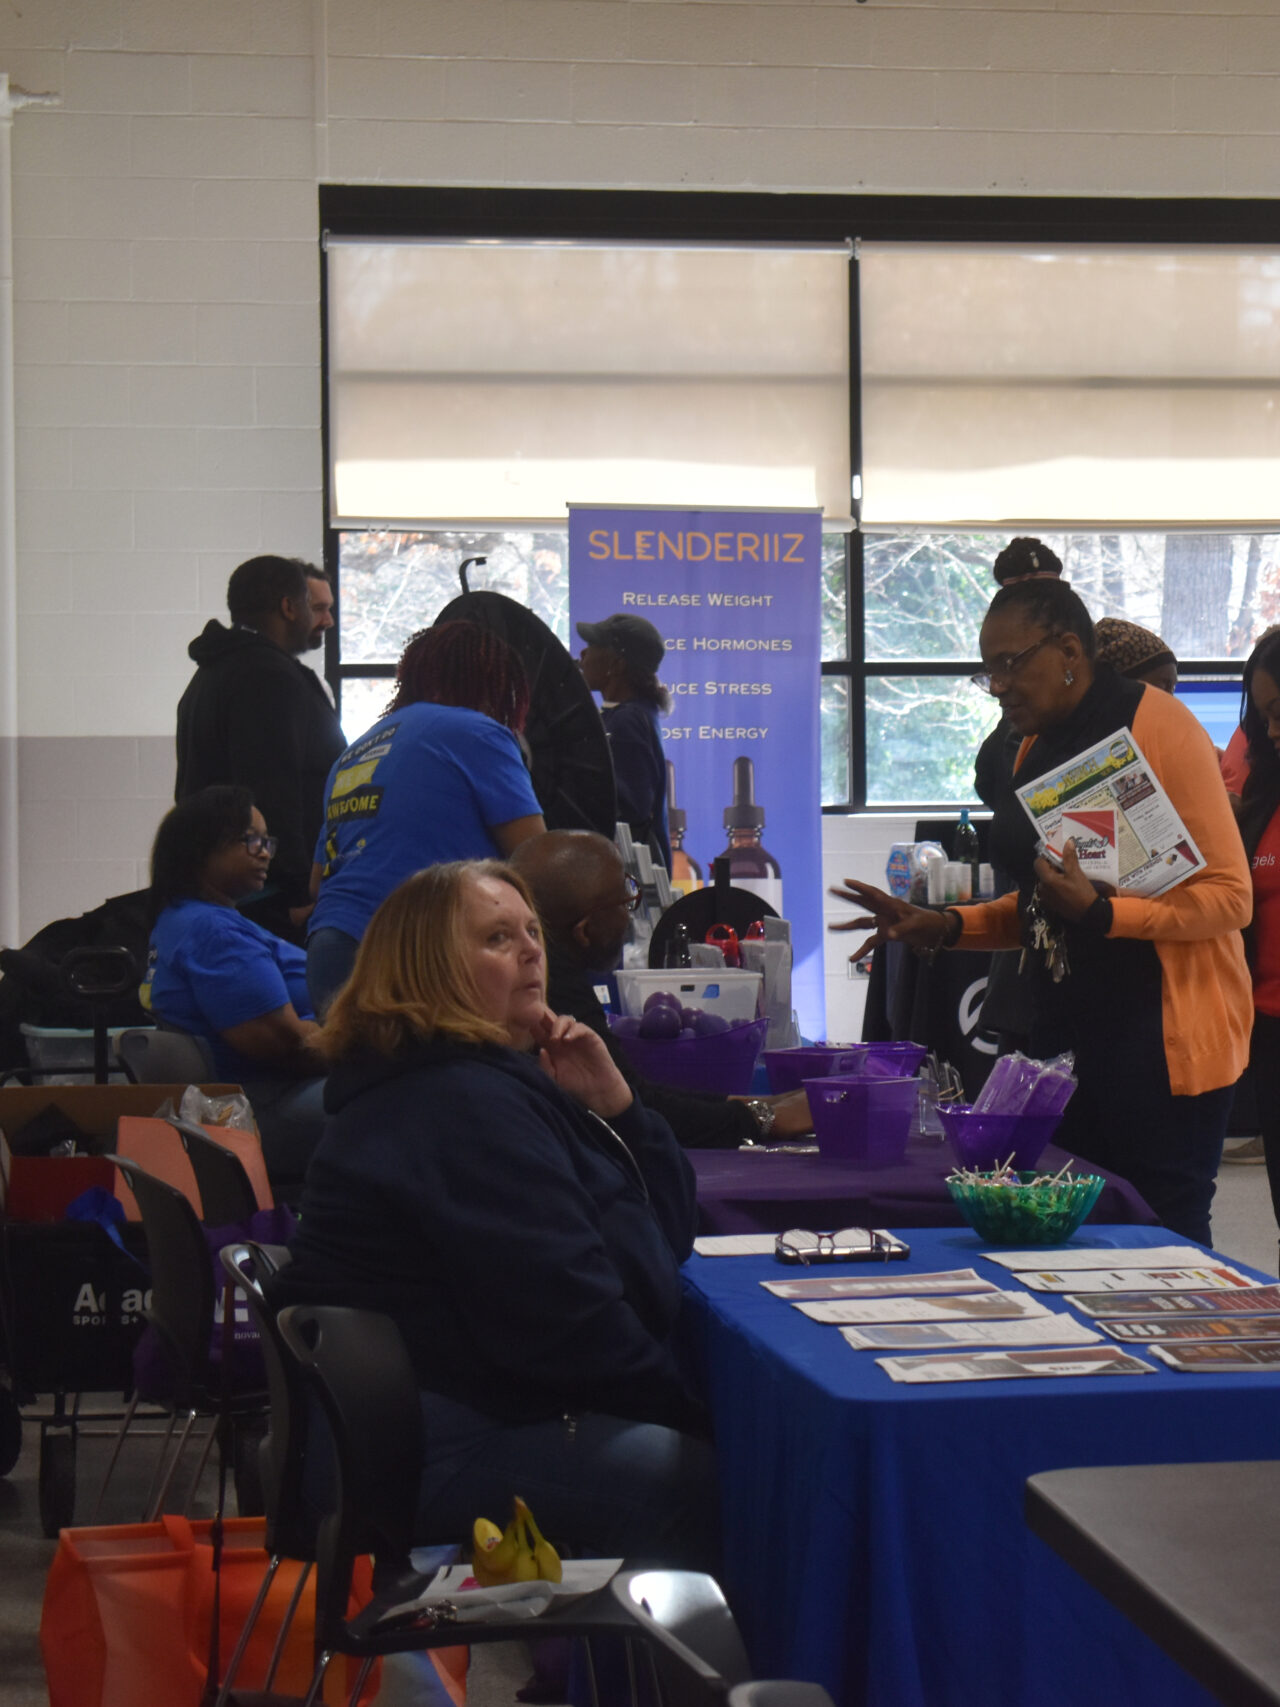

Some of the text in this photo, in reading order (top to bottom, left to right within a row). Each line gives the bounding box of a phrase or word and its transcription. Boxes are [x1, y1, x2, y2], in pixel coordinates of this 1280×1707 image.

[588, 530, 805, 563] SLENDERIIZ
[327, 795, 379, 820] AWESOME
[1251, 852, 1276, 869] gels
